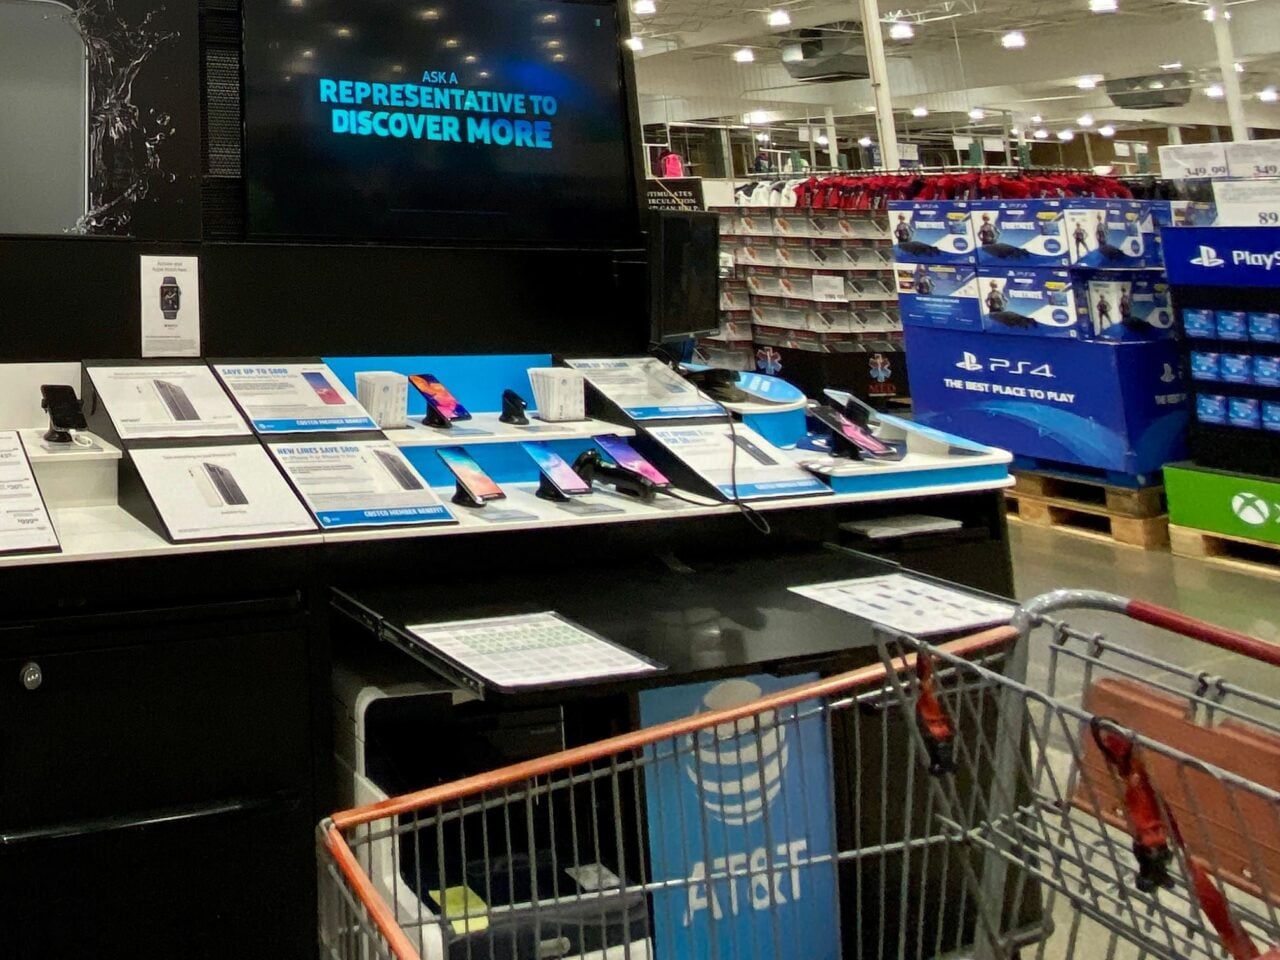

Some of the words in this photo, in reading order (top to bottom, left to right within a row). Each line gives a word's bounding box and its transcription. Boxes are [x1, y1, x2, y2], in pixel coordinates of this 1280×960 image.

[422, 71, 446, 84] ASK
[449, 73, 458, 84] A
[320, 79, 525, 114] REPRESENTATIVE
[529, 95, 558, 116] TO
[332, 109, 462, 142] DISCOVER
[467, 117, 552, 149] MORE
[989, 357, 1053, 378] PS4
[944, 379, 963, 389] THE
[965, 381, 989, 392] BEST
[992, 384, 1026, 398] PLACE
[1029, 389, 1044, 400] TO
[1047, 391, 1075, 404] PLAY
[390, 509, 417, 517] MEMBER
[418, 507, 443, 515] BENEFIT
[683, 838, 807, 927] AT&T
